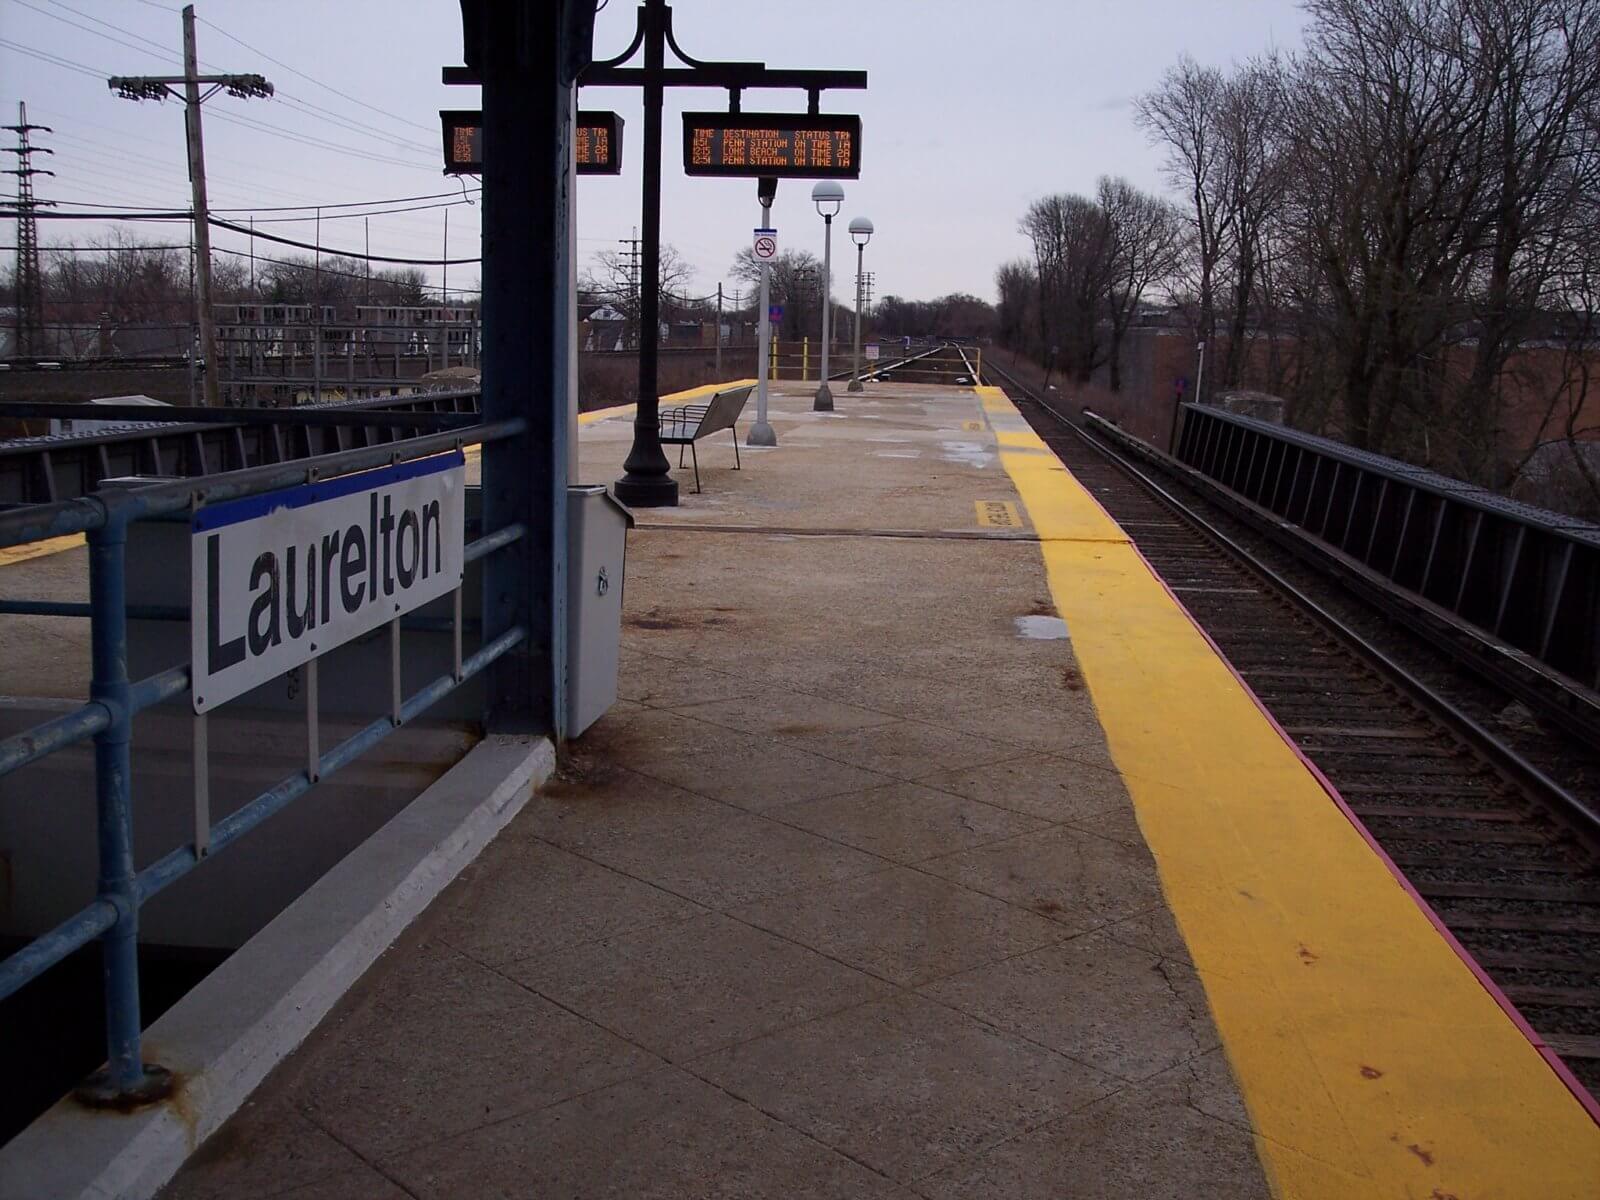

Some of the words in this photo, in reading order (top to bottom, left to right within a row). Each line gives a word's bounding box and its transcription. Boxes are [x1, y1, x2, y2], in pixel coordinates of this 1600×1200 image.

[693, 128, 714, 138] TIME
[723, 128, 779, 139] DESTINATION
[795, 130, 831, 140] STATUS
[723, 138, 745, 147] PENN
[750, 138, 788, 148] STATION
[794, 139, 806, 148] ON
[811, 139, 832, 149] TIME
[723, 147, 745, 156] LONG
[750, 147, 778, 156] BEACH
[794, 148, 806, 157] ON
[811, 148, 832, 157] TIME
[722, 155, 745, 165] PENN
[749, 156, 787, 165] STATION
[794, 157, 806, 166] ON
[811, 157, 832, 166] TIME
[207, 491, 441, 676] Laurelton
